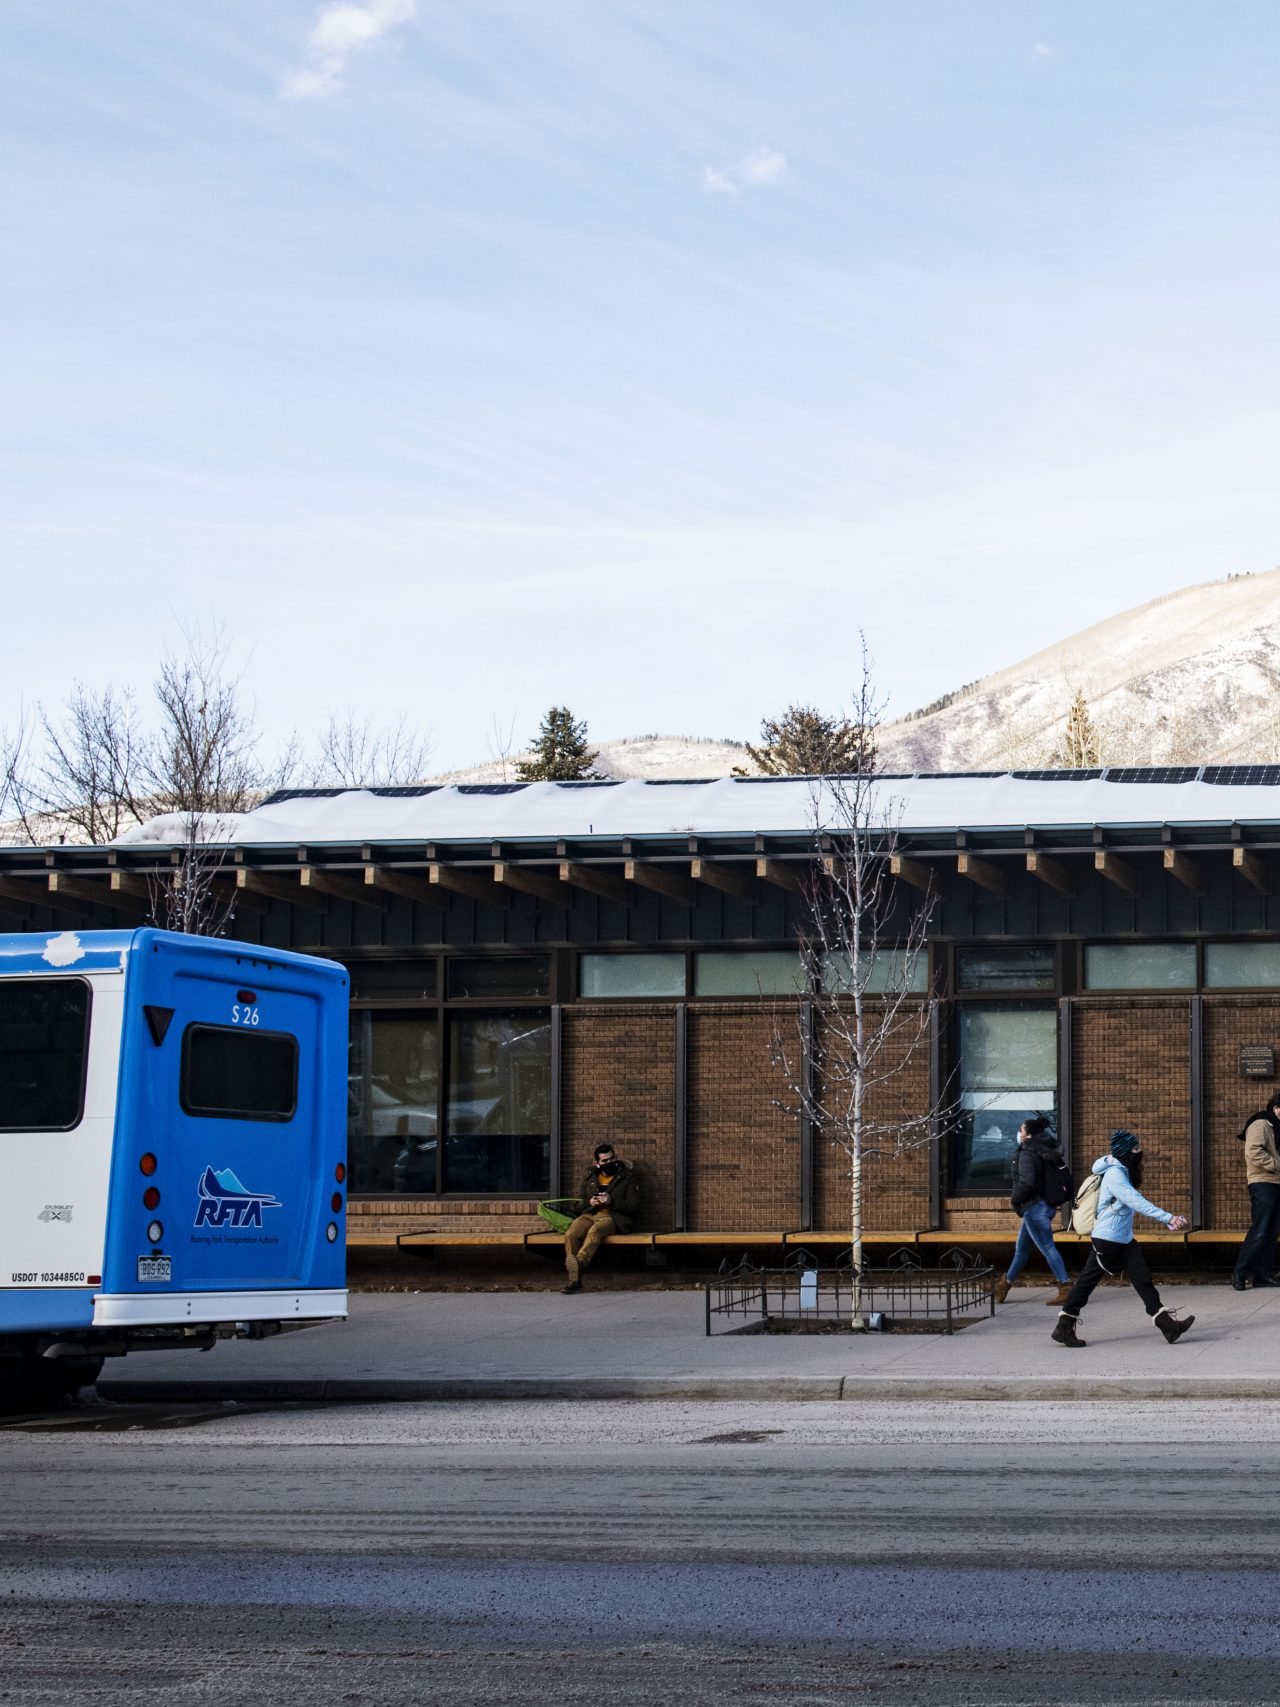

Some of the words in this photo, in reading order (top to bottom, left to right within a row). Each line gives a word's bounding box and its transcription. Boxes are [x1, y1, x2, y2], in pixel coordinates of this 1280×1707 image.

[231, 1005, 240, 1023] S
[242, 1006, 259, 1026] 26
[194, 1198, 262, 1228] RFTA
[12, 1272, 38, 1282] USDOT
